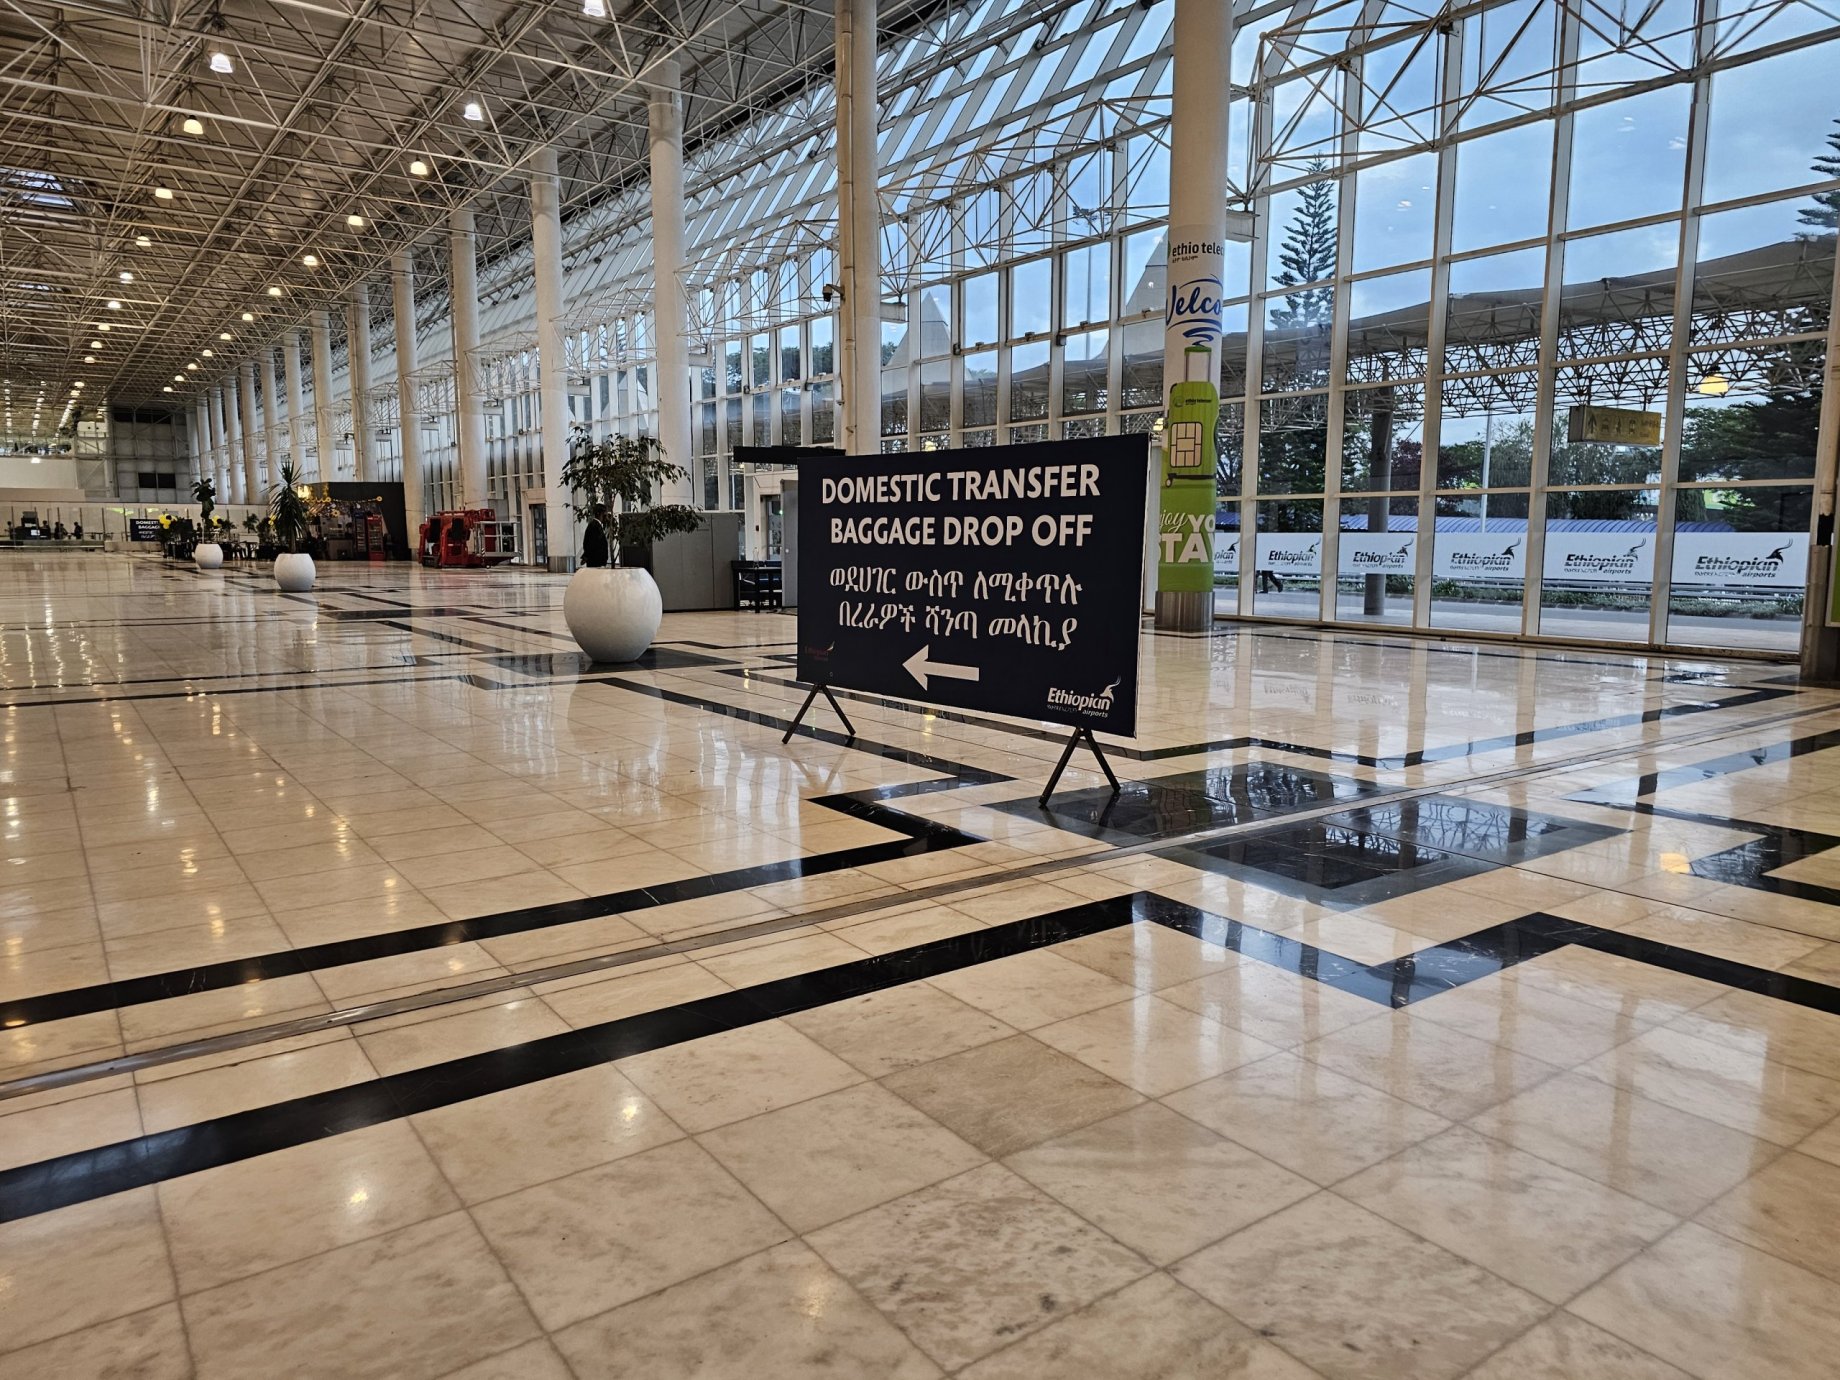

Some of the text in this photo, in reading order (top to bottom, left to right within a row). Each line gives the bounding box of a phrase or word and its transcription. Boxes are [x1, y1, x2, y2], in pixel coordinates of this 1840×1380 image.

[1172, 242, 1199, 256] ethio
[822, 463, 1101, 504] DOMESTIC TRANSFER
[831, 514, 1094, 547] BAGGAGE DROP OFF
[1268, 550, 1314, 564] Ethiopian
[1353, 551, 1406, 566] Ethiopian
[1451, 552, 1511, 568] Ethiopian
[1564, 553, 1635, 571] Ethiopian
[1695, 556, 1779, 574] Ethiopian
[829, 566, 1083, 605] ወደሀገር ውስጥ ለሚቀጥሉ
[839, 600, 1078, 651] በረራዎች ሻንጣ መላኪያ
[1047, 687, 1112, 711] Ethiopian
[1082, 709, 1108, 718] airports
